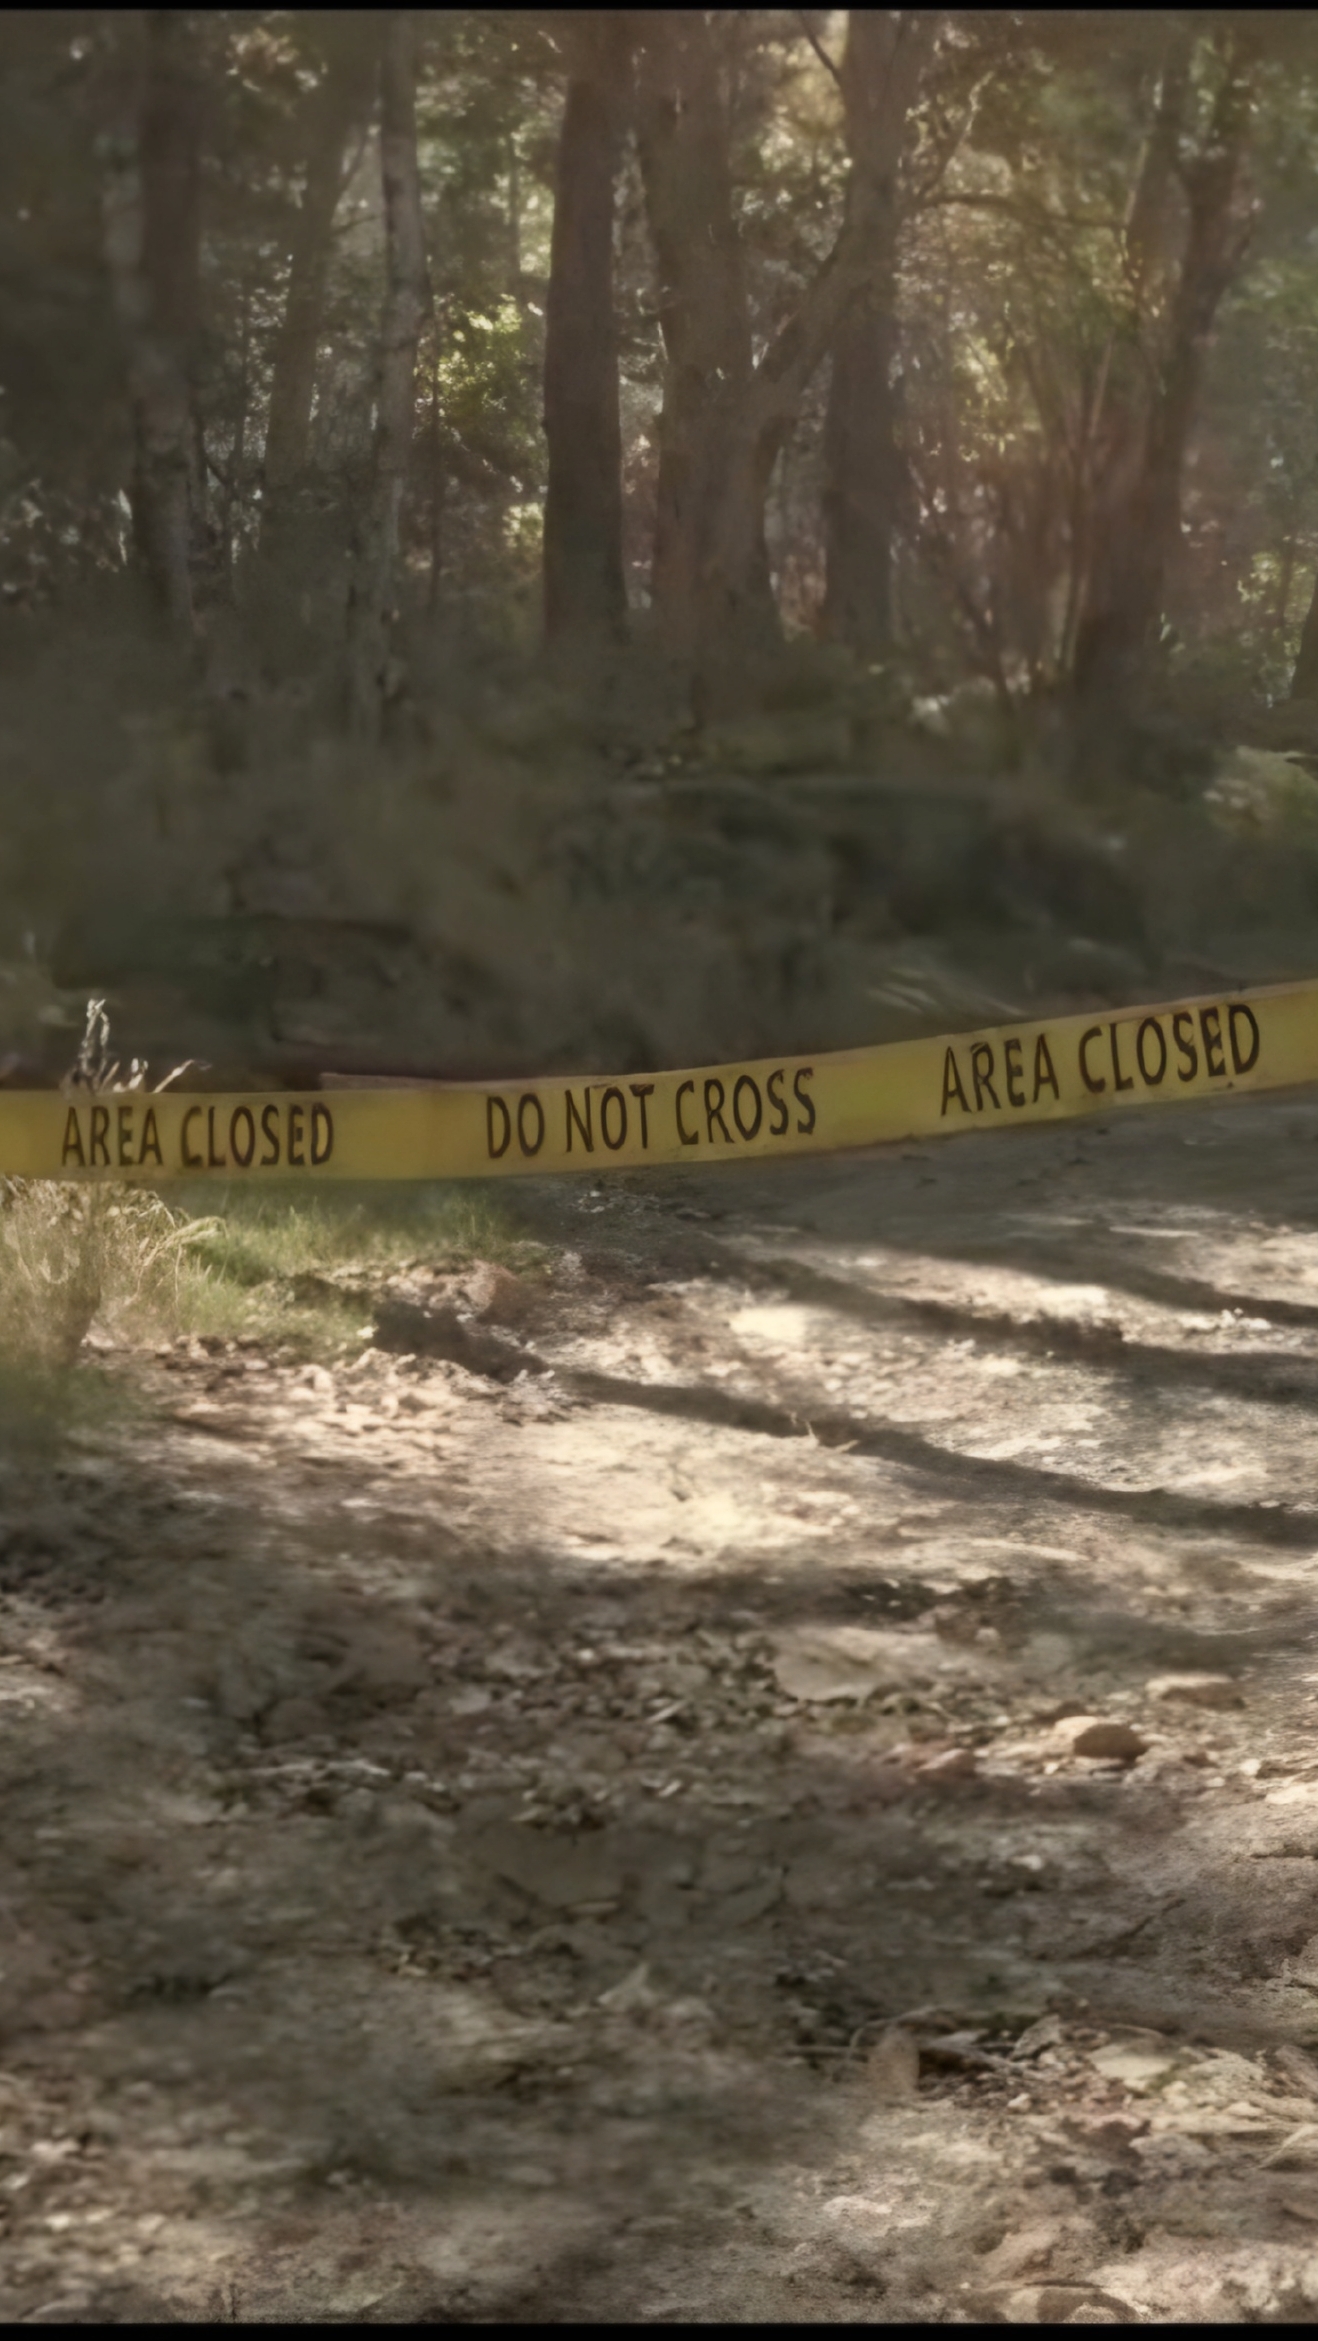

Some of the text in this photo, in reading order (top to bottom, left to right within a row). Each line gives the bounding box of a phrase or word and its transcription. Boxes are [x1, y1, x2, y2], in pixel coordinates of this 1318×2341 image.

[940, 1003, 1261, 1117] AREA CLOSED
[61, 1102, 335, 1168] AREA CLOSED
[485, 1067, 817, 1159] DO NOT CROSS
